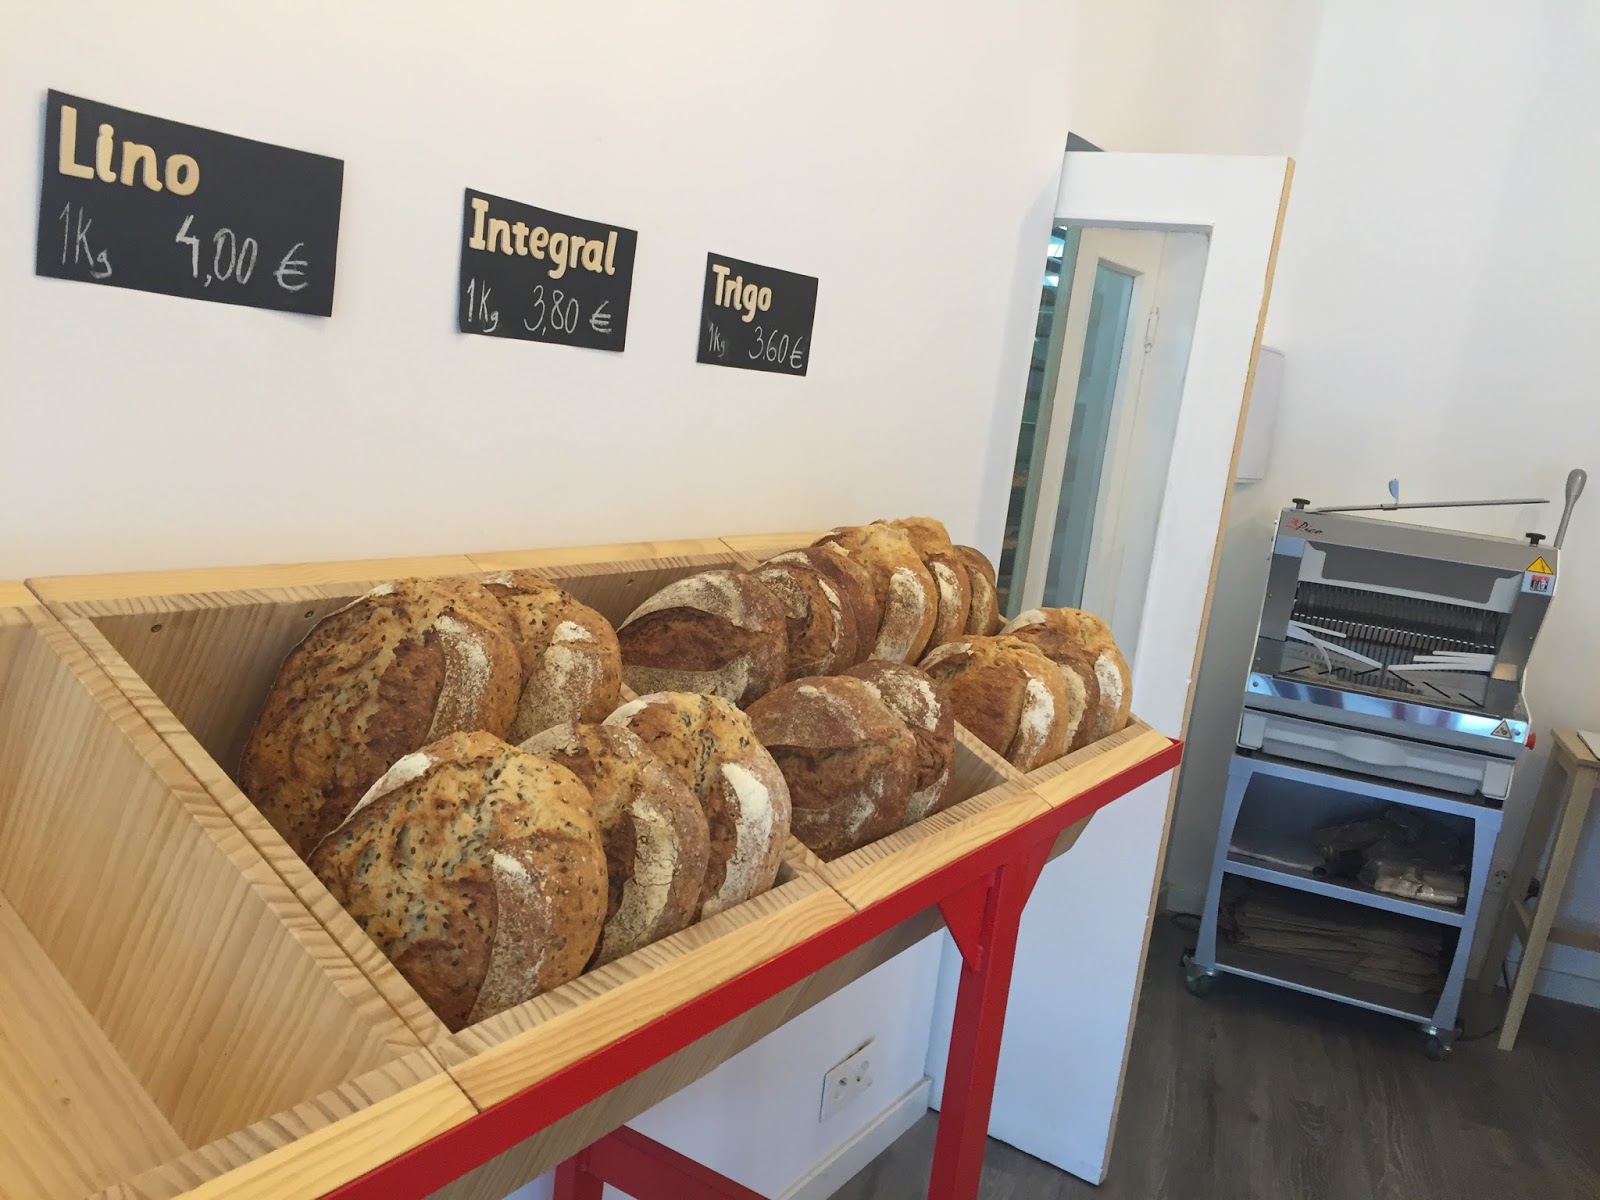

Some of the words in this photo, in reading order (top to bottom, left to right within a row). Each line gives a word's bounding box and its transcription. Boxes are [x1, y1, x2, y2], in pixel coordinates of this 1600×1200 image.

[58, 104, 200, 196] Lino
[272, 242, 309, 293] €
[468, 197, 618, 280] Integral
[712, 263, 773, 323] Trigo
